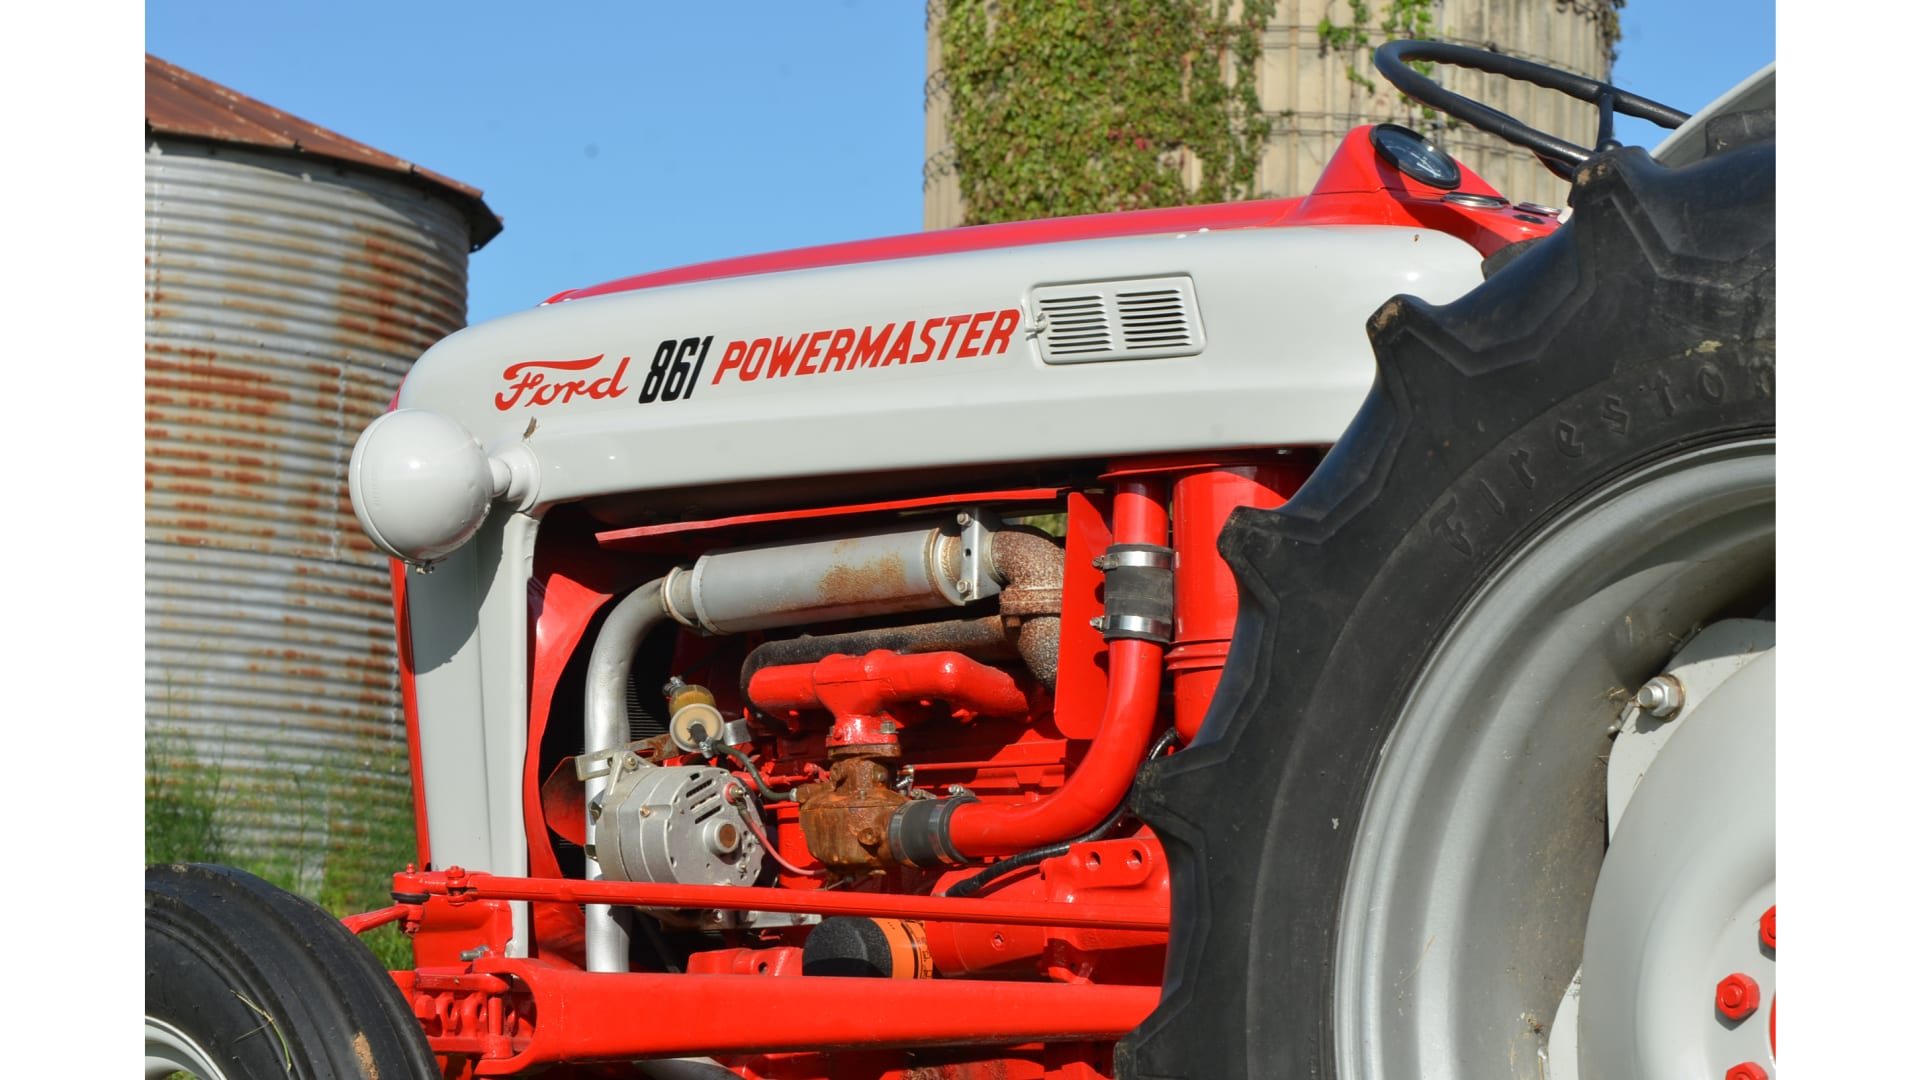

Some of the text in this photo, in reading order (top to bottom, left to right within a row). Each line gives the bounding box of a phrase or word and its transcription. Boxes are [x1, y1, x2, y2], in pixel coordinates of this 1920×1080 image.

[495, 308, 1021, 411] Ford 861 POWERMASTER
